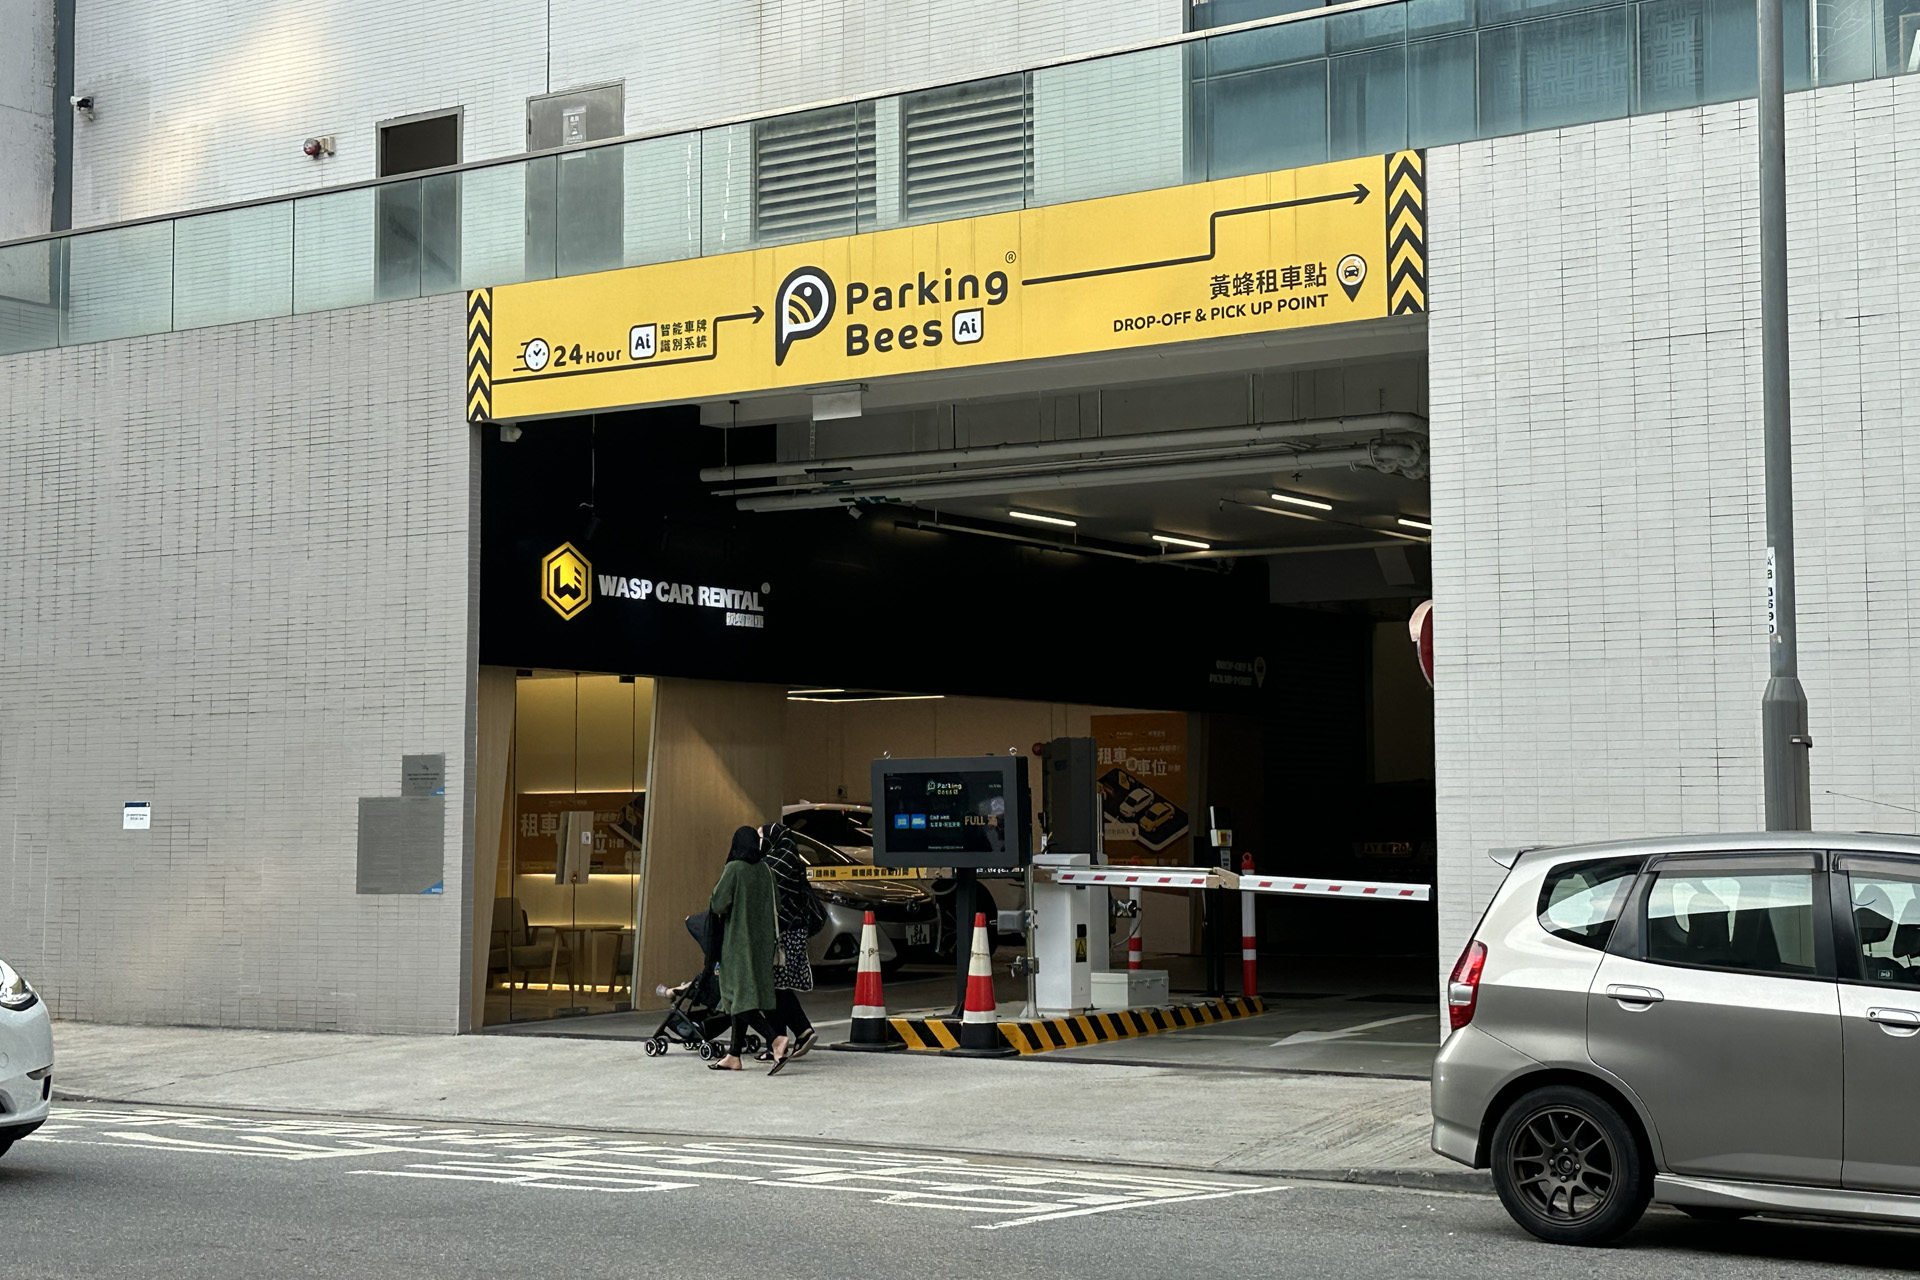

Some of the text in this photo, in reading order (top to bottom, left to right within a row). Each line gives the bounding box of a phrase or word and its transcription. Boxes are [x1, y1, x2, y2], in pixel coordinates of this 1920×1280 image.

[847, 267, 1008, 315] Parking
[1209, 262, 1328, 300] 黃蜂租車點
[660, 318, 707, 337] 智能車牌
[1113, 294, 1329, 332] DROP-OFF & PICK UP POINT
[553, 343, 622, 367] 24 Hour
[634, 333, 651, 350] Ai
[660, 335, 707, 353] 識別系統
[847, 318, 977, 357] Bees Ai
[598, 574, 764, 612] WASP CAR RENTAL
[964, 815, 986, 826] FULL
[344, 1142, 970, 1193] CLEAR
[752, 1164, 1263, 1214] KEEP
